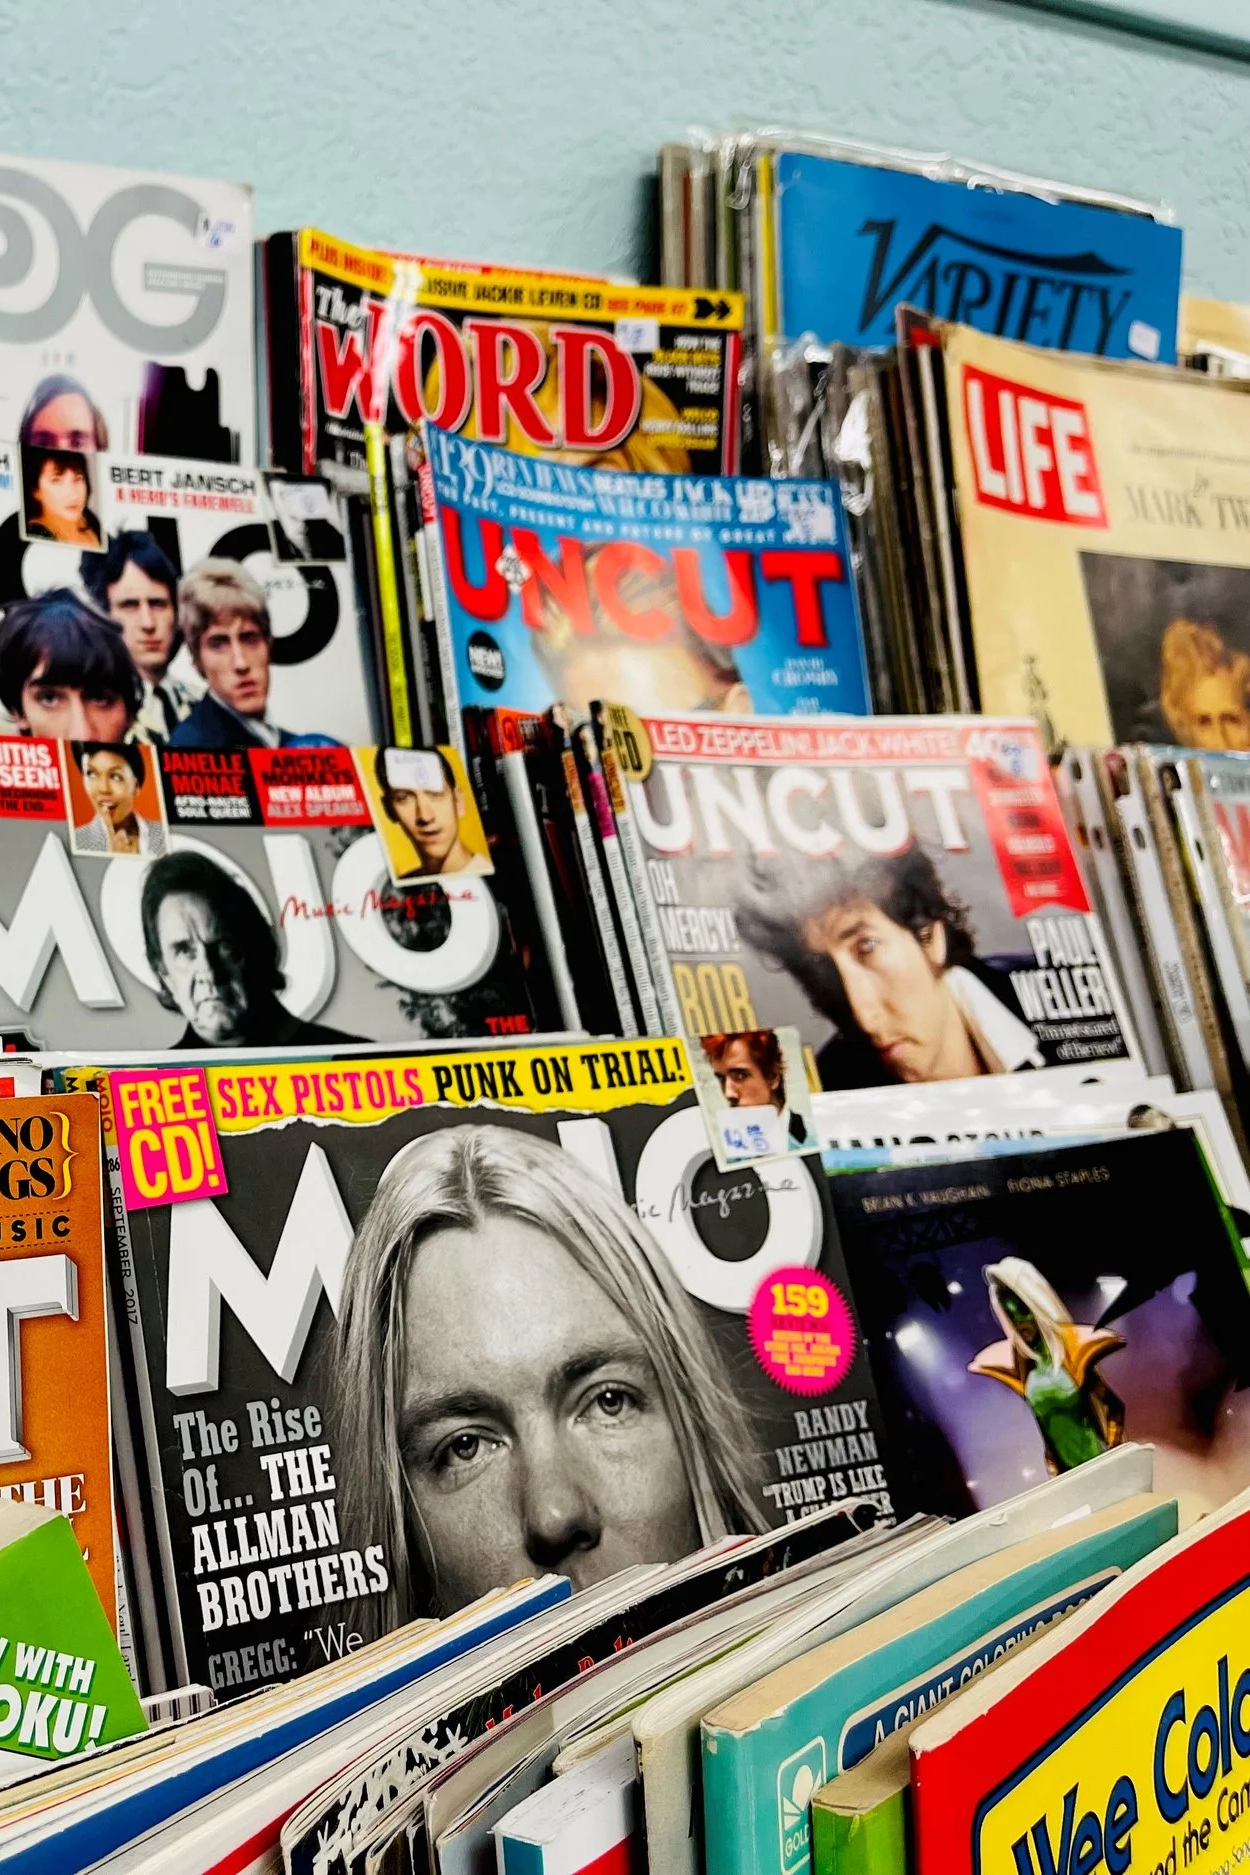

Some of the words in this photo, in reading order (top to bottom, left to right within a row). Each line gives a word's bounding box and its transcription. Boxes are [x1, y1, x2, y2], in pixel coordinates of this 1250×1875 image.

[856, 218, 1136, 356] VARIETY
[317, 299, 641, 451] WORD
[966, 378, 1101, 519] LIFE
[110, 465, 165, 493] BERT
[170, 467, 258, 496] JANSCH
[440, 505, 844, 648] UNCUT
[162, 752, 246, 774] JANELLE
[270, 754, 338, 770] ARCTIC
[652, 722, 699, 754] LED
[815, 728, 872, 760] JACK
[261, 770, 355, 786] MONKEYS
[268, 785, 303, 801] NEW
[304, 784, 356, 801] ALBUM
[0, 801, 20, 812] THE
[630, 764, 970, 858] UNCUT
[1026, 915, 1099, 969] PAUL
[1009, 967, 1116, 1022] WELLER
[484, 1014, 532, 1036] THE
[96, 1077, 113, 1133] MOJO
[118, 1075, 208, 1129] FREE
[216, 1076, 288, 1121] SEX
[293, 1068, 425, 1114] PISTOLS
[431, 1059, 524, 1103] PUNK
[531, 1055, 575, 1094] ON
[579, 1046, 688, 1091] TRIAL!
[129, 1120, 221, 1199] CD!
[111, 1187, 132, 1280] SEPTEMBER
[124, 1288, 138, 1326] 2017
[770, 1282, 830, 1318] 159
[173, 1408, 241, 1463] The
[250, 1396, 324, 1448] Rise
[793, 1400, 870, 1440] RANDY
[774, 1431, 880, 1477] NEWMAN
[827, 1471, 849, 1498] IS
[846, 1463, 889, 1494] LIKE
[181, 1466, 257, 1518] Of...
[259, 1446, 338, 1499] THE
[189, 1497, 342, 1577] ALLMAN
[196, 1544, 391, 1634] BROTHERS
[15, 1640, 98, 1699] WITH
[206, 1634, 300, 1694] GREGG:
[1011, 1775, 1140, 1875] Wee
[1182, 1818, 1212, 1869] the
